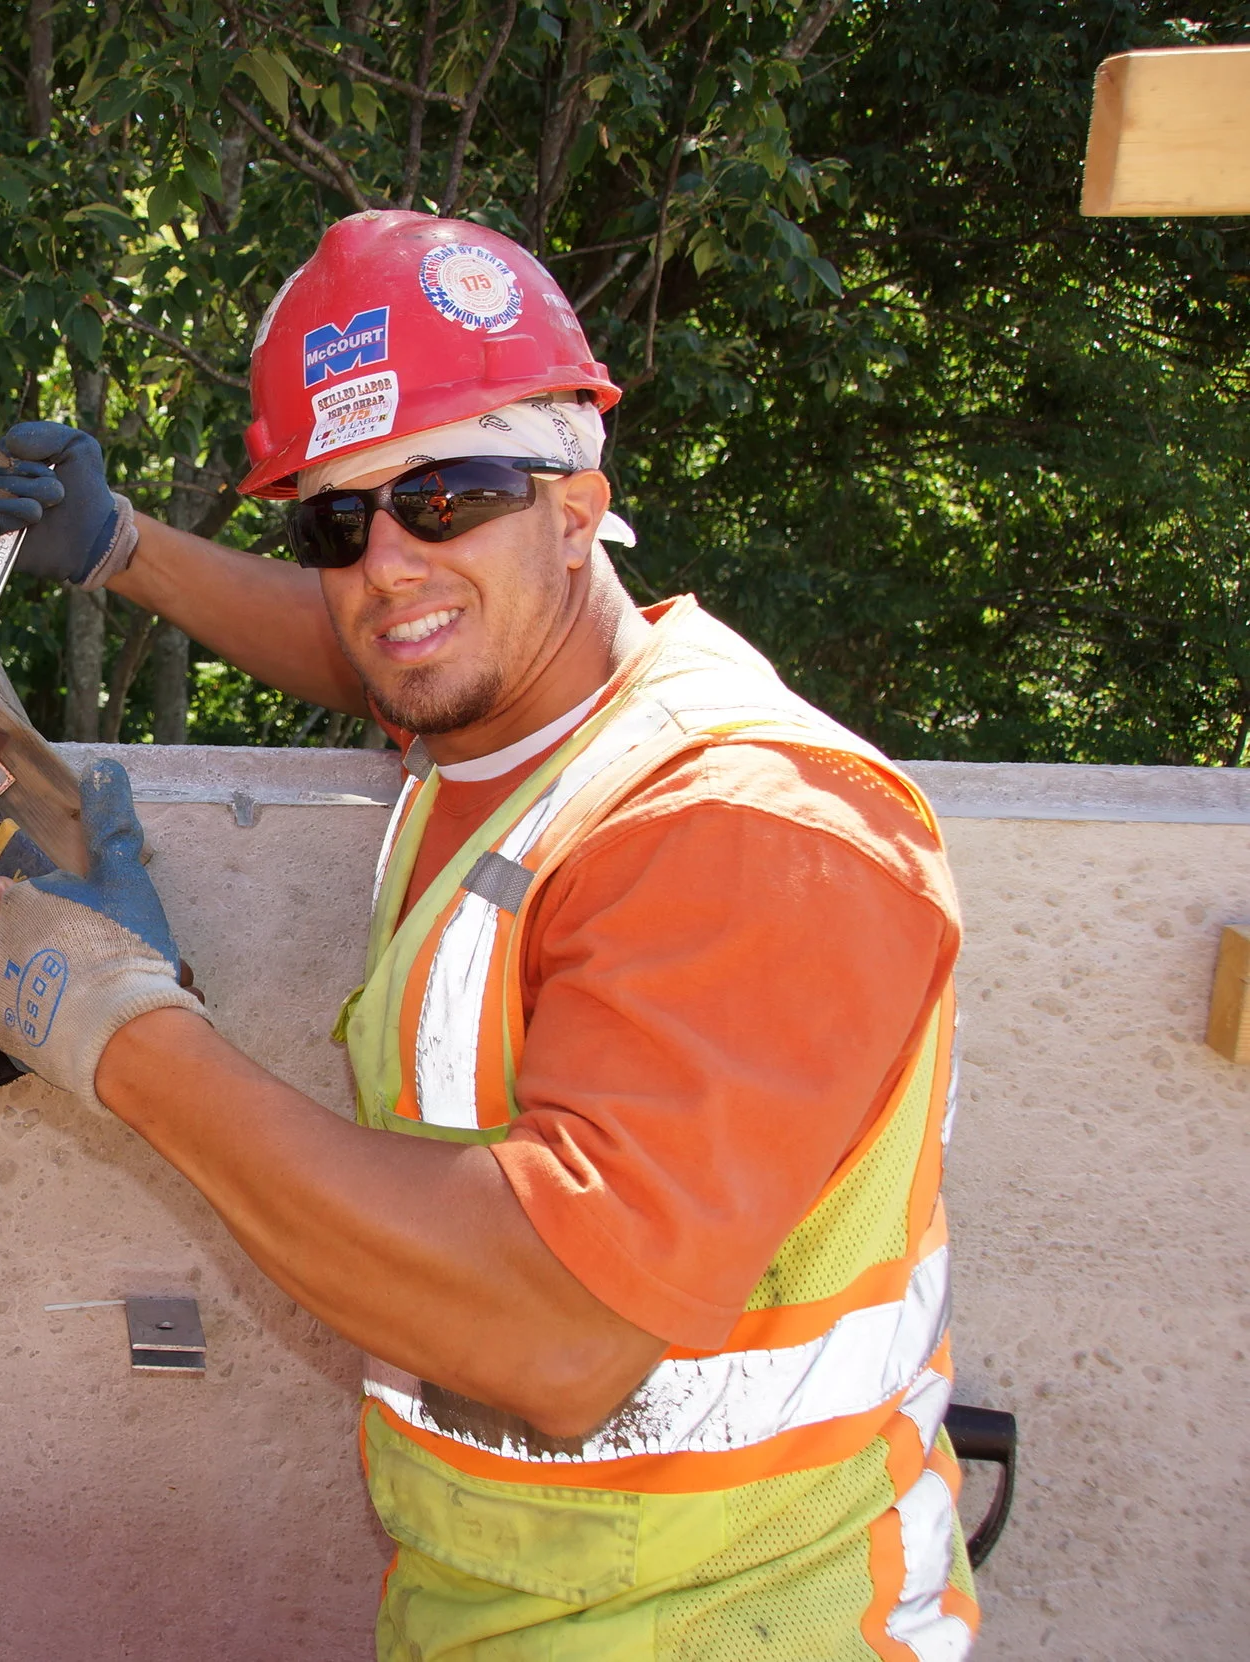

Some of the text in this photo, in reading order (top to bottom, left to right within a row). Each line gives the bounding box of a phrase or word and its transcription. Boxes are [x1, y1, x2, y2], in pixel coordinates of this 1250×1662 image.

[425, 246, 457, 287] AMERICAN
[457, 246, 472, 254] BY
[477, 248, 510, 275] BIRTH
[460, 274, 491, 291] 175
[446, 291, 520, 328] UNION BY CHOICE
[306, 328, 384, 367] McCOURT
[317, 378, 392, 411] SKILLED LABOR
[338, 408, 371, 426] 175
[25, 955, 62, 1039] BOSS
